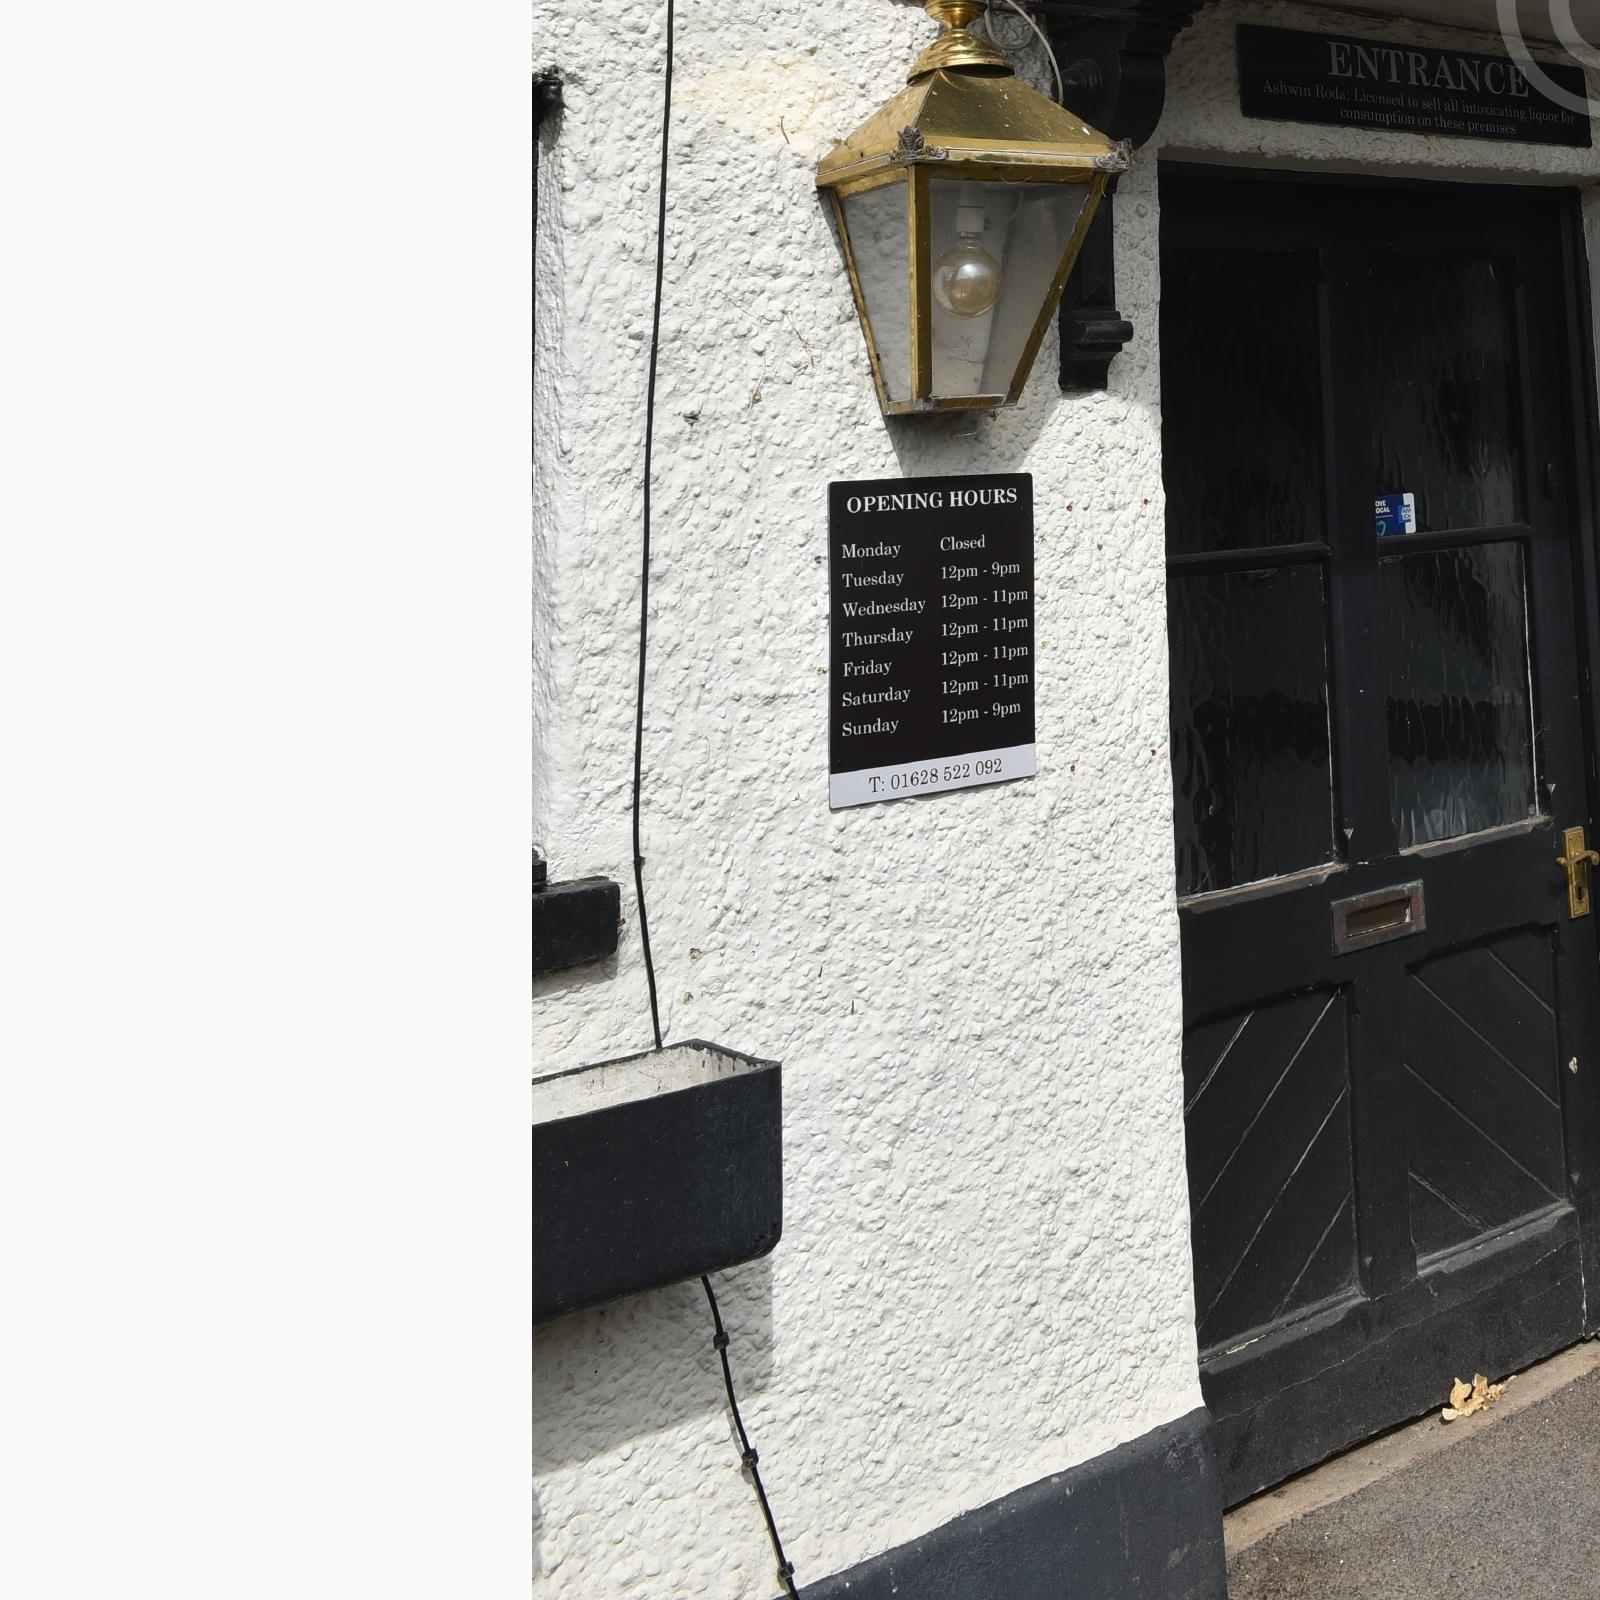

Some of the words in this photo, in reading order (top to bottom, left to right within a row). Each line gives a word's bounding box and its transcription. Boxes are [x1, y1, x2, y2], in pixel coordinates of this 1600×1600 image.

[1326, 41, 1529, 98] ENTRANCE
[1263, 79, 1311, 97] Ashwin
[1354, 88, 1405, 107] Licensed
[1408, 97, 1419, 108] to
[1422, 97, 1441, 111] sell
[1444, 98, 1459, 112] all
[1462, 99, 1526, 122] intoxicating
[1528, 107, 1558, 126] liquor
[1560, 110, 1575, 126] for
[1340, 108, 1415, 126] consumption
[1417, 116, 1432, 127] on
[1435, 114, 1465, 130] these
[846, 491, 944, 514] OPENING
[948, 486, 1018, 508] HOURS
[841, 543, 902, 559] Monday
[940, 533, 986, 552] Closed
[842, 572, 905, 588] Tuesday
[940, 564, 979, 581] 12pm
[991, 561, 1021, 578] 9pm
[842, 598, 927, 619] Wednesday
[940, 593, 979, 610] 12pm
[992, 589, 1029, 606] 11pm
[842, 627, 914, 648] Thursday
[940, 621, 979, 639] 12pm
[992, 616, 1029, 634] 11pm
[842, 659, 893, 678] Friday
[940, 650, 979, 669] 12pm
[992, 645, 1029, 662] 11pm
[841, 687, 912, 707] Saturday
[940, 678, 979, 697] 12pm
[992, 672, 1030, 691] 11pm
[841, 719, 900, 737] Sunday
[941, 707, 980, 725] 12pm
[992, 701, 1022, 719] 9pm
[868, 776, 886, 793] T:
[890, 768, 939, 791] 01628
[943, 763, 971, 782] 522
[974, 758, 1003, 777] 092
